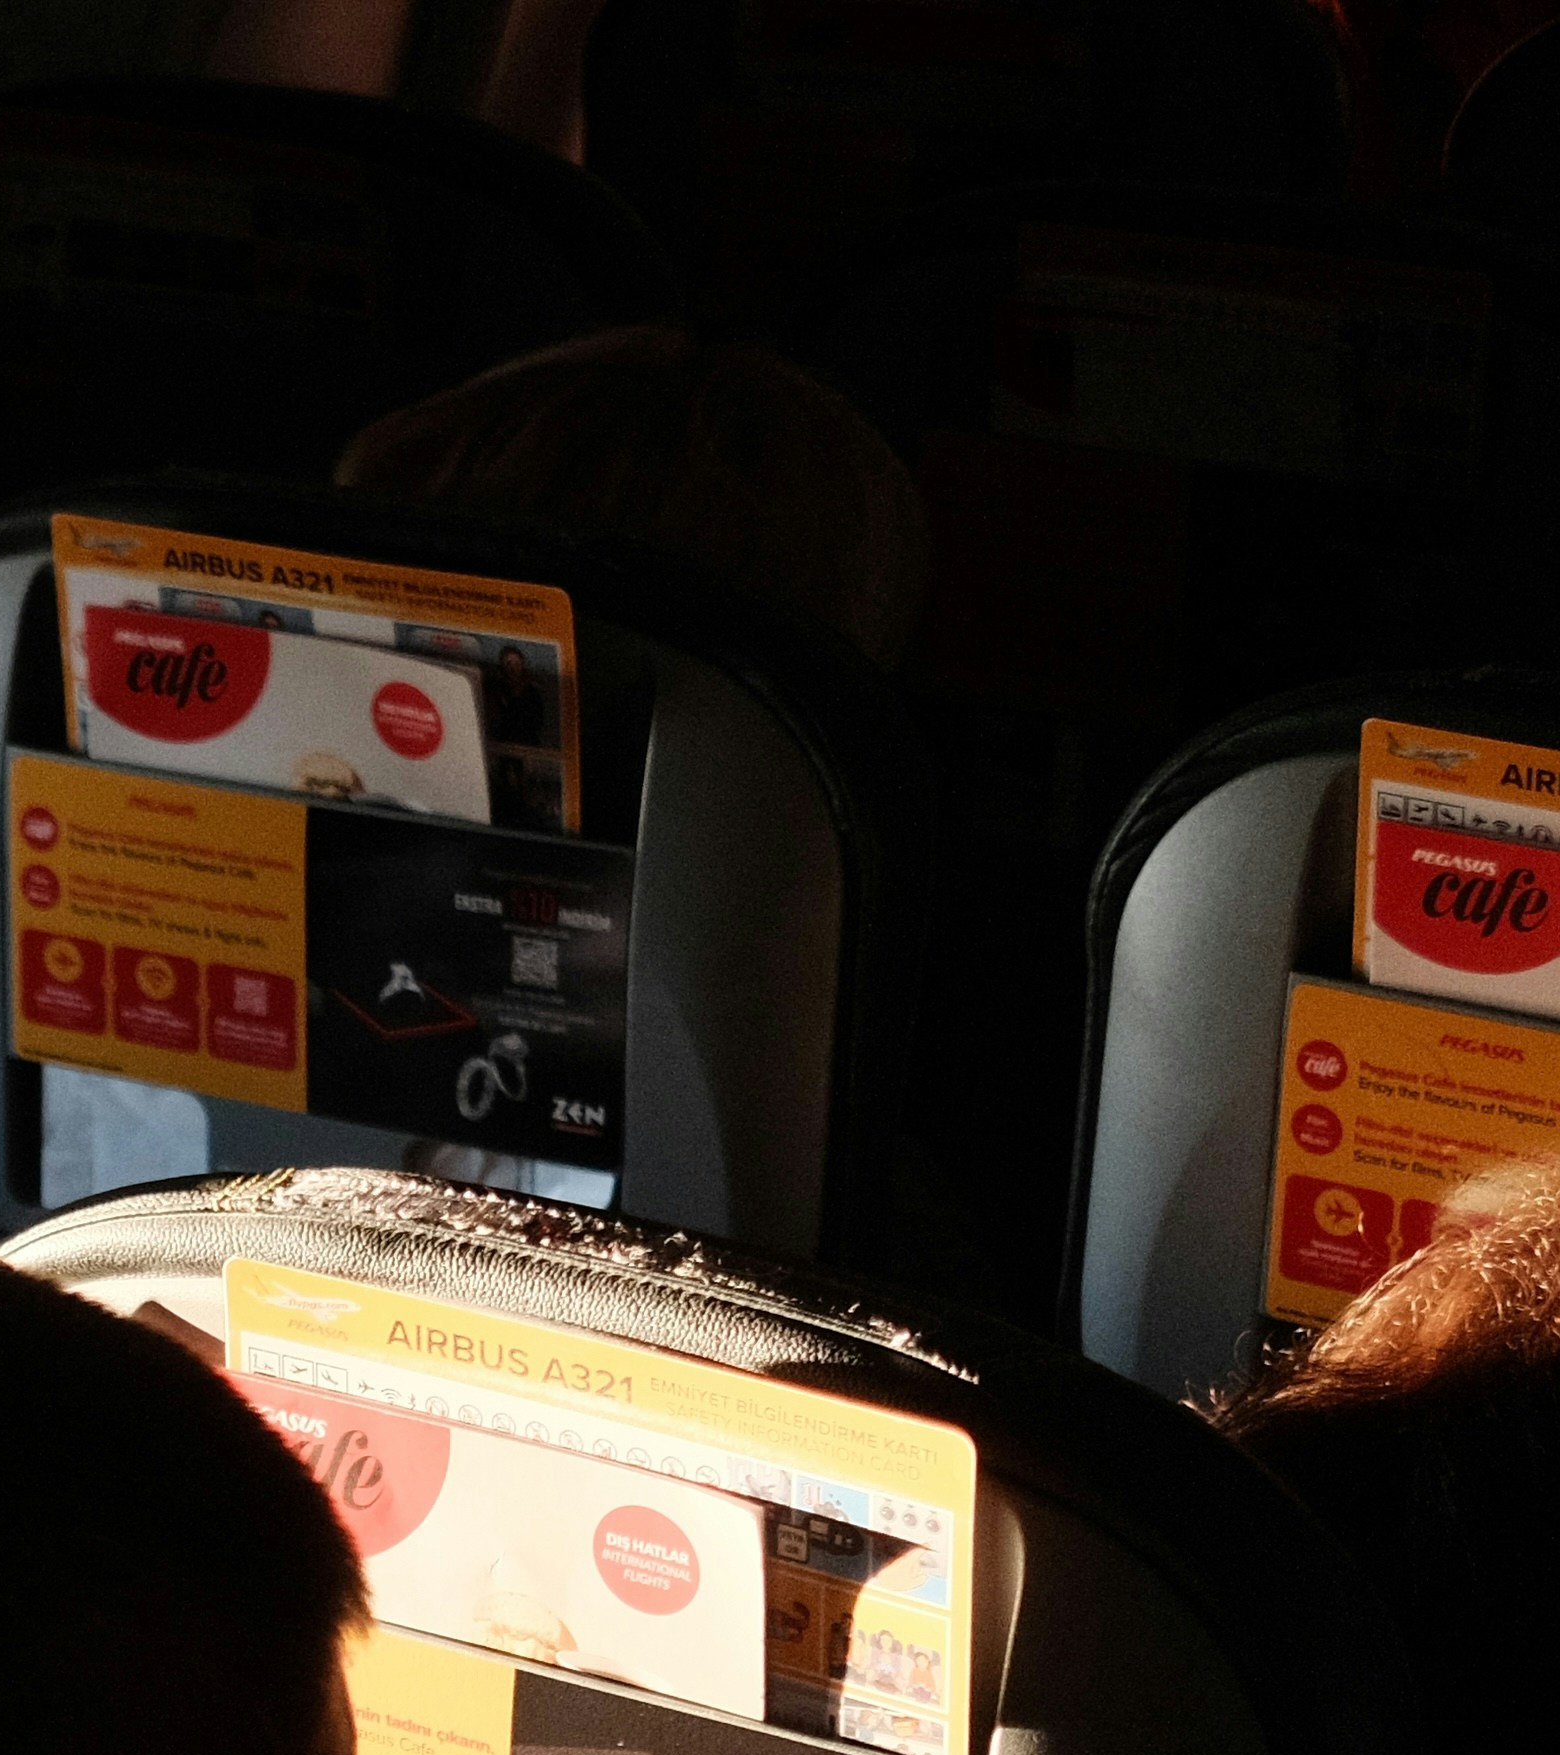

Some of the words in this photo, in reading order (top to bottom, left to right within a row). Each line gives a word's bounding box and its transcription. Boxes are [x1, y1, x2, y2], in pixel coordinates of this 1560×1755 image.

[164, 548, 264, 583] AIRBUS
[271, 565, 335, 595] A321
[127, 644, 227, 710] cafe
[1412, 849, 1497, 876] PEGASUS
[1423, 868, 1549, 938] cafe
[386, 1317, 530, 1378] AIRBUS
[540, 1355, 634, 1404] A321
[870, 1454, 921, 1483] CARD
[882, 1436, 937, 1466] KARTI
[602, 1548, 692, 1583] INTERNATIONAL
[605, 1530, 629, 1553] DIŞ
[632, 1538, 689, 1567] HATLAR
[623, 1567, 670, 1592] FLIGHTS
